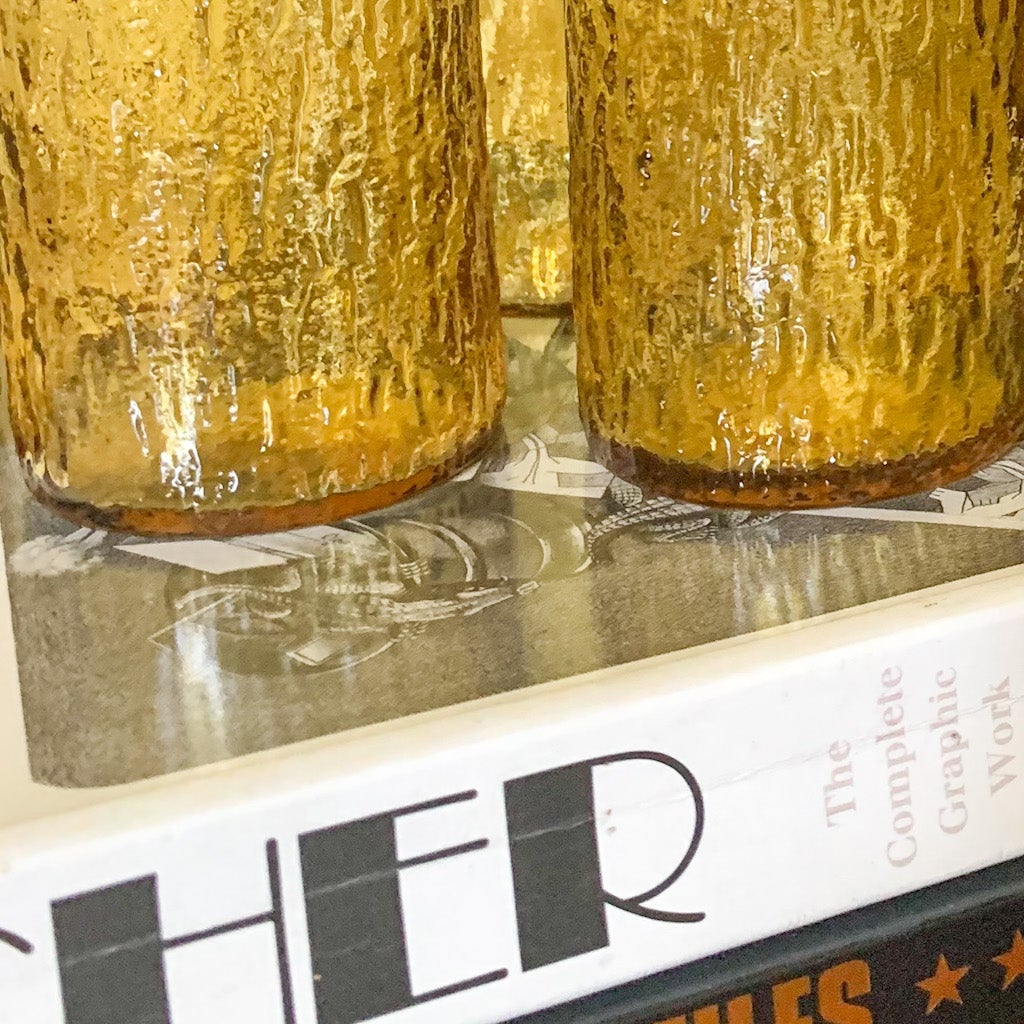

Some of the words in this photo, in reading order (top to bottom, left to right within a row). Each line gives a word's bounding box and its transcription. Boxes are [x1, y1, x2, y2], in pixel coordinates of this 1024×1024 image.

[823, 738, 858, 828] The
[875, 664, 918, 868] Complete
[927, 666, 970, 836] Graphic
[980, 675, 1018, 796] Work
[0, 750, 706, 1024] HER
